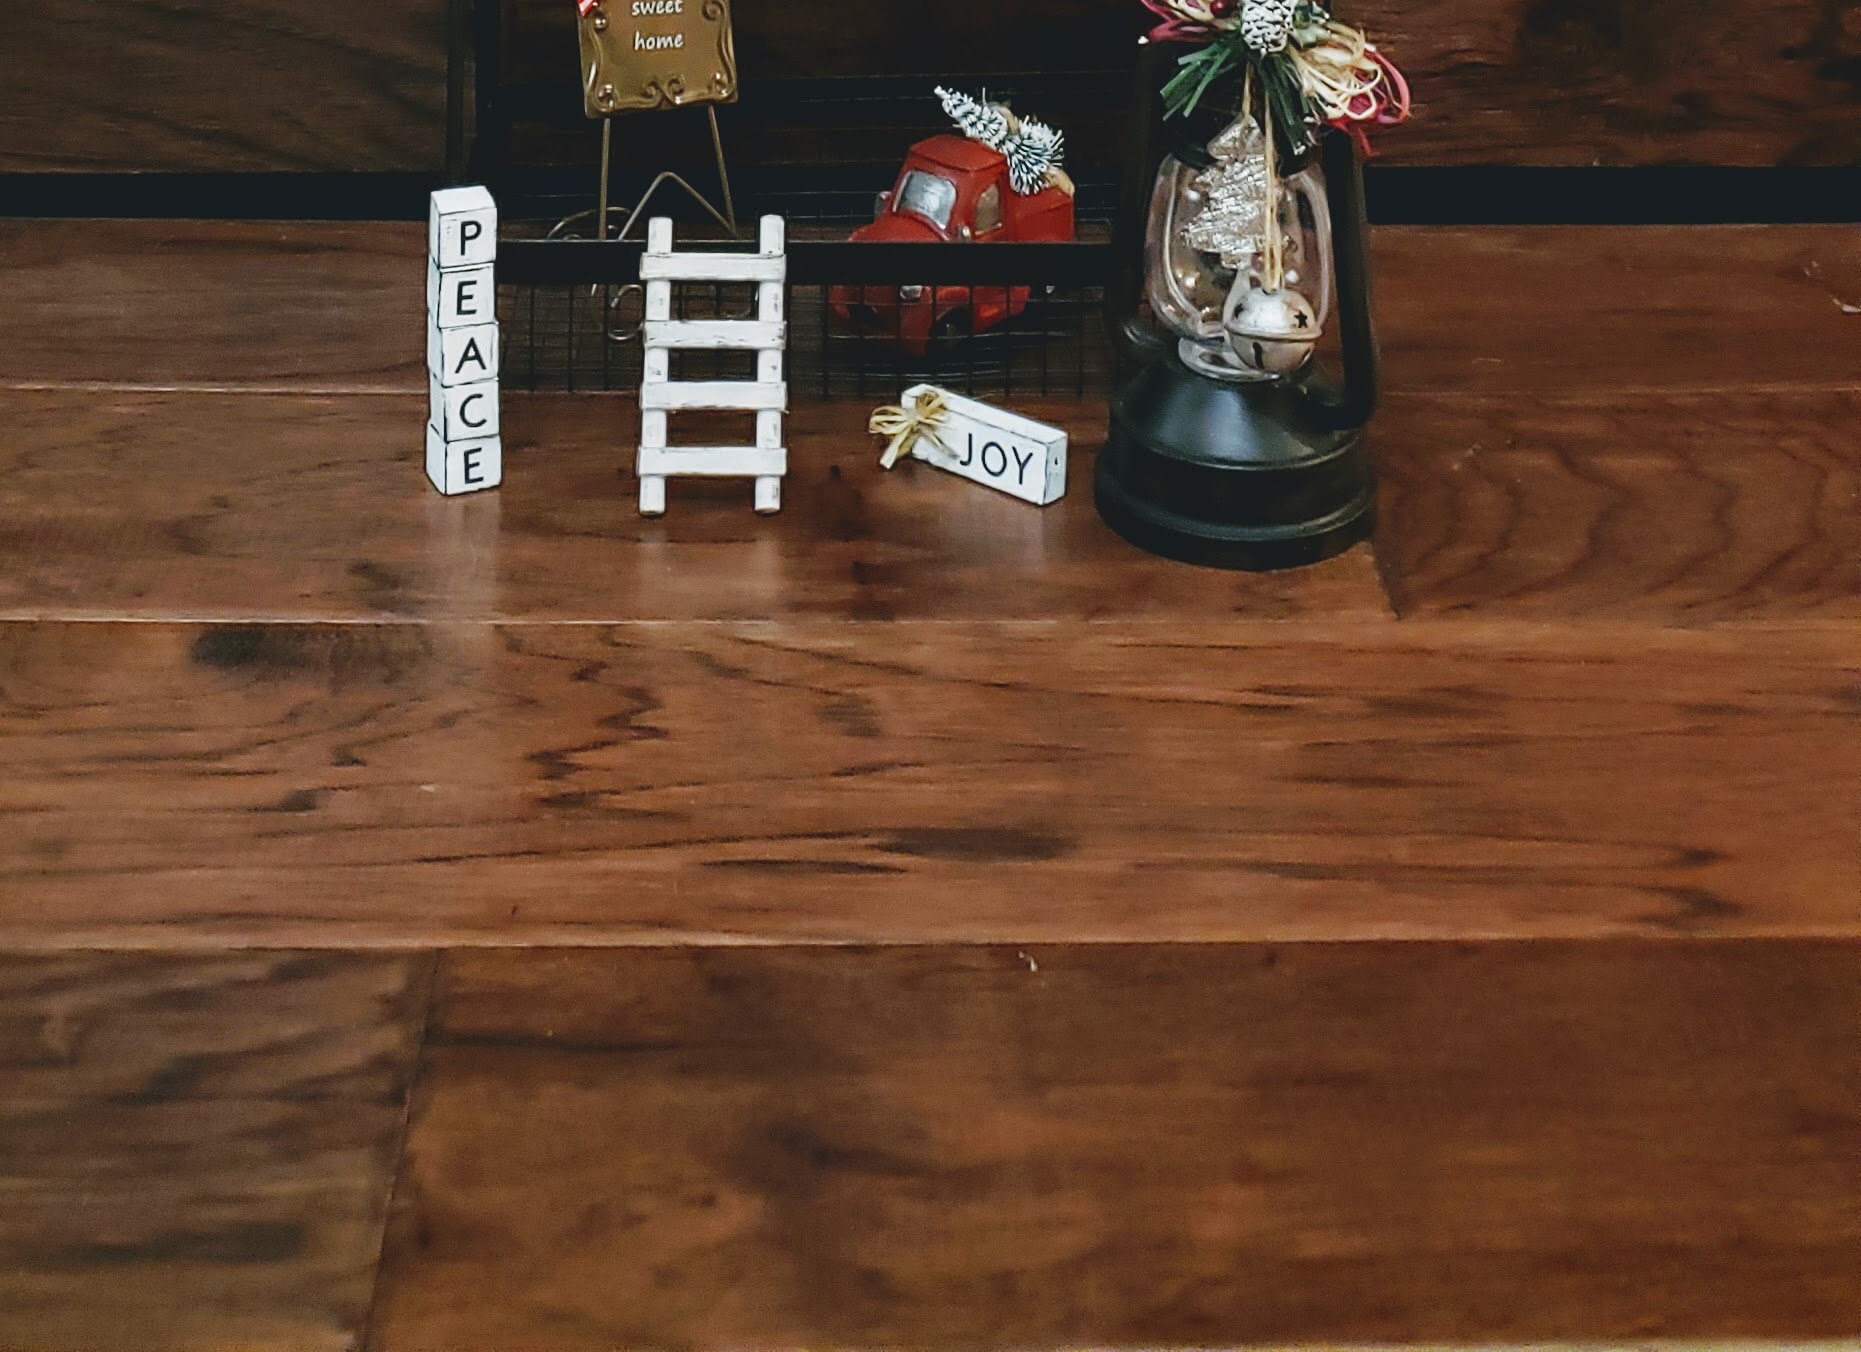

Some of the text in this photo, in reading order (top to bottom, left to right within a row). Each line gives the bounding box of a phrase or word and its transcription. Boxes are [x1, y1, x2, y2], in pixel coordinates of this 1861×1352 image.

[634, 30, 684, 51] home
[454, 219, 488, 485] PEACE
[959, 433, 1034, 485] JOY
